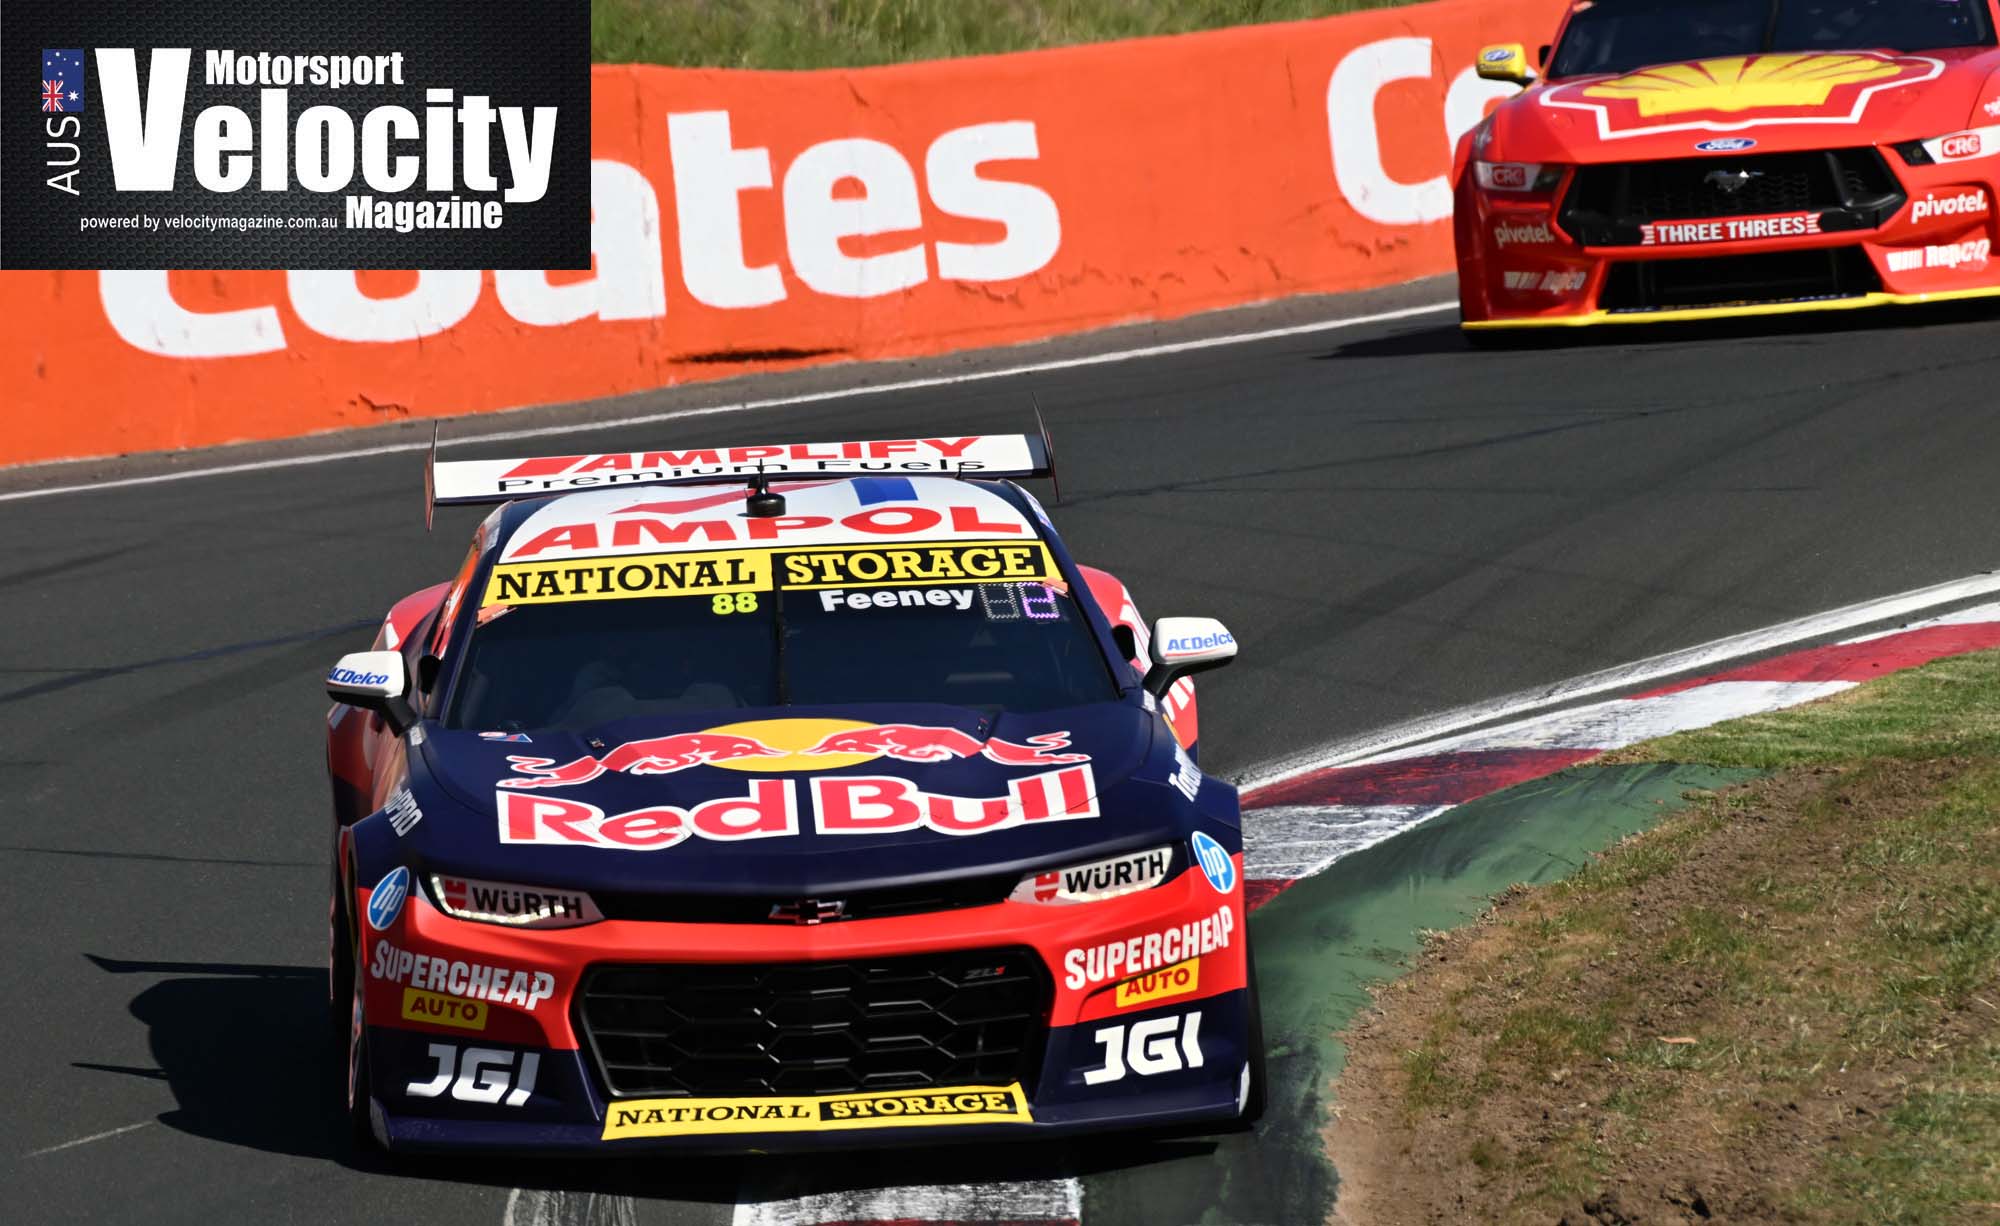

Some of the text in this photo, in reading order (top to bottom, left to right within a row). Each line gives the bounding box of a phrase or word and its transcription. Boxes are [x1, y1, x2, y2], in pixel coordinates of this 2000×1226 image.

[1942, 136, 1980, 157] CRC
[1494, 167, 1525, 185] CRC
[1657, 217, 1807, 243] THREE THREES
[1925, 239, 1991, 268] Repco
[498, 456, 985, 492] Premium Fuels
[572, 437, 981, 475] AMPLIFY
[509, 505, 1022, 558] AMPOL
[496, 546, 1035, 600] NATIONAL STORAGE
[712, 593, 759, 615] 88
[819, 584, 974, 612] Feeney
[1167, 632, 1234, 651] ACDelco
[498, 765, 1099, 849] Red Bull
[1065, 851, 1166, 894] WÜRTH
[1194, 833, 1232, 892] hp
[368, 867, 408, 929] hp
[472, 886, 583, 920] WÜRTH
[1064, 905, 1234, 990] SUPERCHEAP
[371, 938, 555, 1011] SUPERCHEAP
[1124, 967, 1191, 998] AUTO
[410, 997, 479, 1022] AUTO
[1083, 1011, 1204, 1086] JGI
[406, 1043, 540, 1107] JGI
[615, 1092, 1009, 1128] NATIONAL STORAGE
